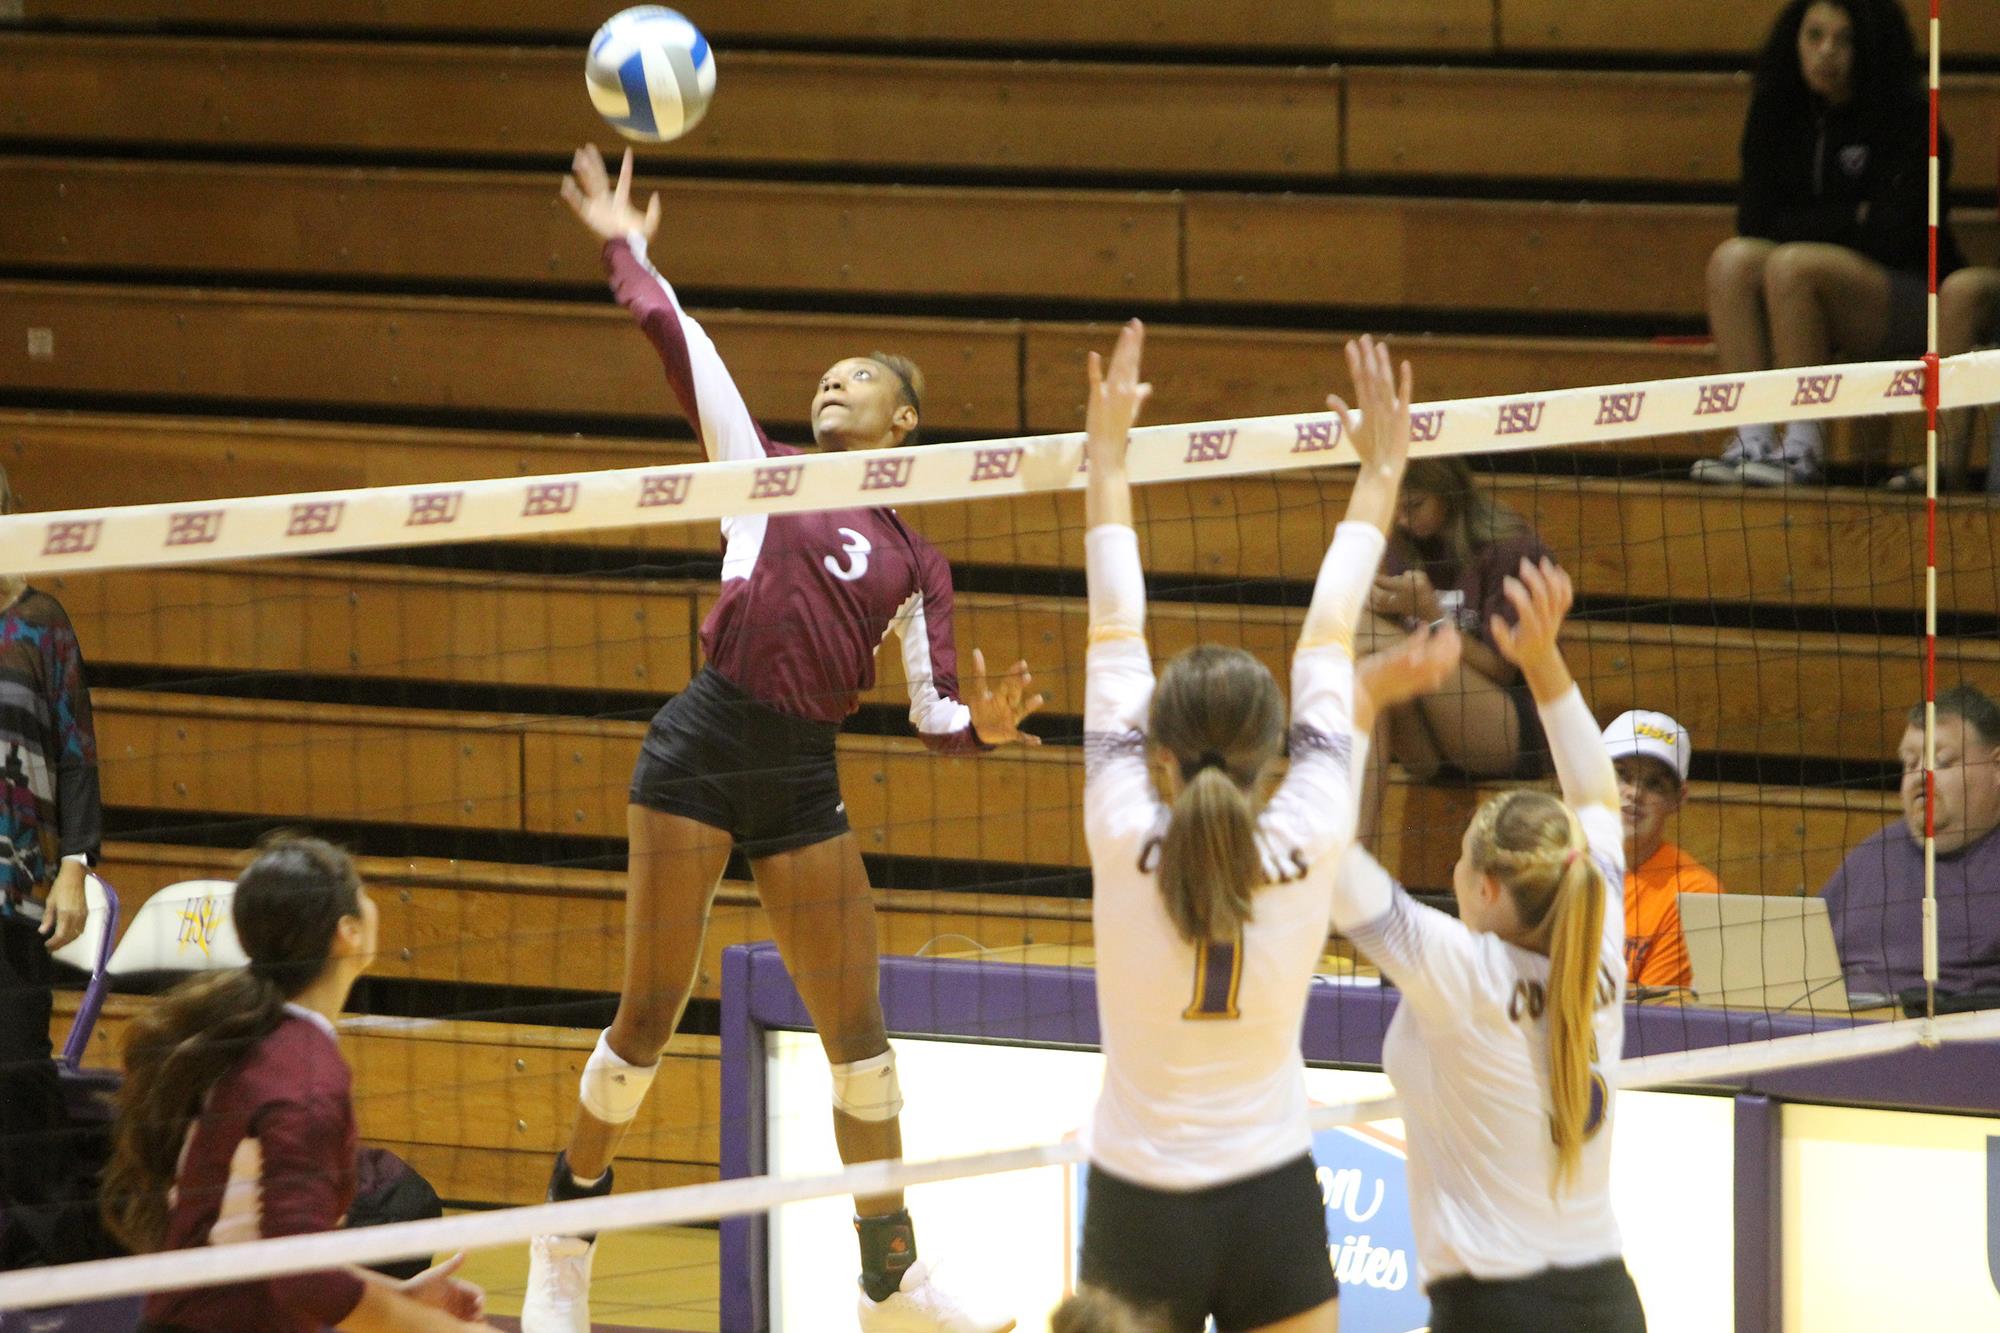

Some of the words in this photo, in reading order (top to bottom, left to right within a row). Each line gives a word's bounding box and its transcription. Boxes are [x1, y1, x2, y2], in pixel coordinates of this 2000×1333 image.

[42, 520, 103, 556] HSU
[166, 510, 226, 547] HSU
[286, 501, 346, 537] HSU
[405, 491, 464, 527] HSU
[521, 482, 579, 517] HSU
[638, 474, 695, 508] HSU
[751, 466, 805, 500] HSU
[861, 457, 916, 491] HSU
[970, 448, 1025, 483] HSU
[1184, 429, 1239, 464] HSU
[1290, 419, 1343, 453] HSU
[1409, 409, 1446, 443] SU
[1495, 401, 1546, 435] HSU
[1595, 391, 1646, 426] HSU
[1695, 383, 1745, 416] HSU
[1791, 374, 1843, 408] HSU
[824, 527, 872, 581] 3
[178, 896, 227, 945] HSU
